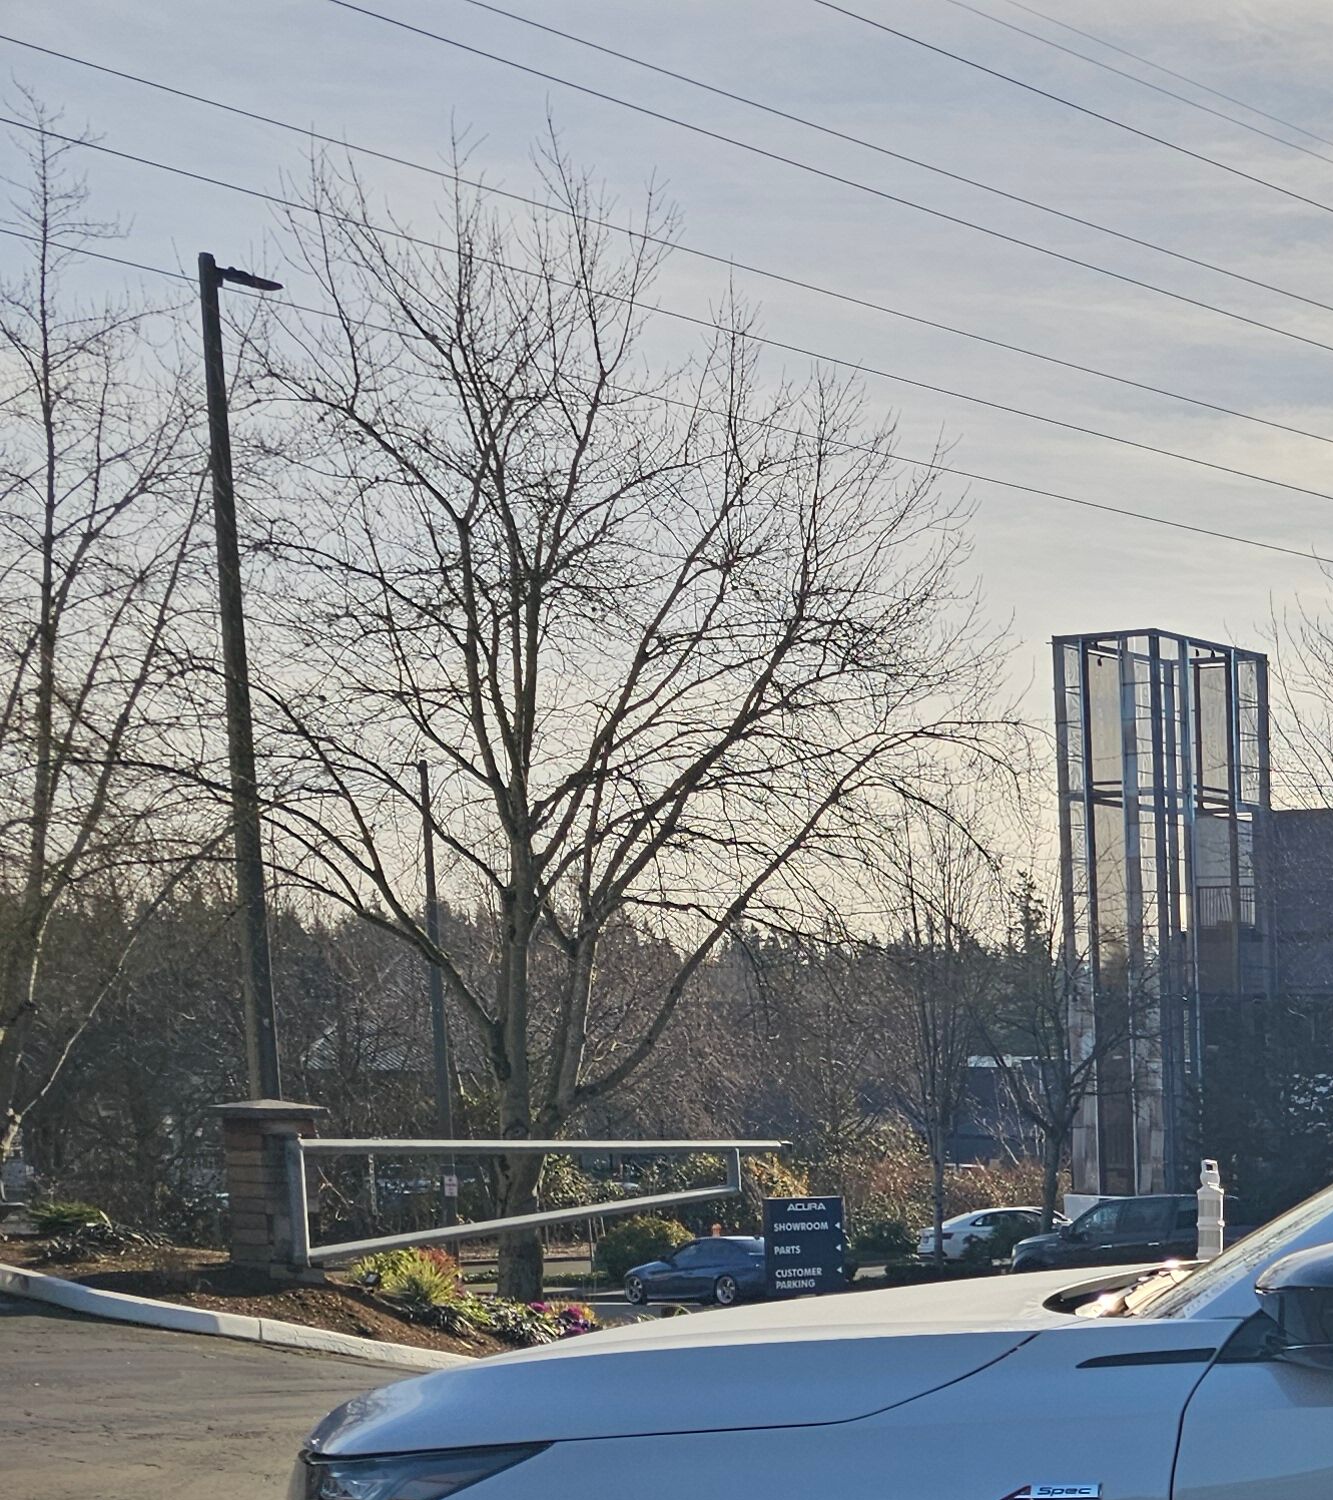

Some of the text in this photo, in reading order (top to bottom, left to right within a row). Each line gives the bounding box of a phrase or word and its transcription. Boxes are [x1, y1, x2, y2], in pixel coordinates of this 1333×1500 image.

[787, 1203, 826, 1211] ACURA
[773, 1222, 829, 1232] SHOWROOM
[774, 1245, 801, 1255] PARTS
[775, 1267, 822, 1278] CUSTOMER
[775, 1279, 815, 1290] PARKING
[1037, 1487, 1092, 1496] Spec
